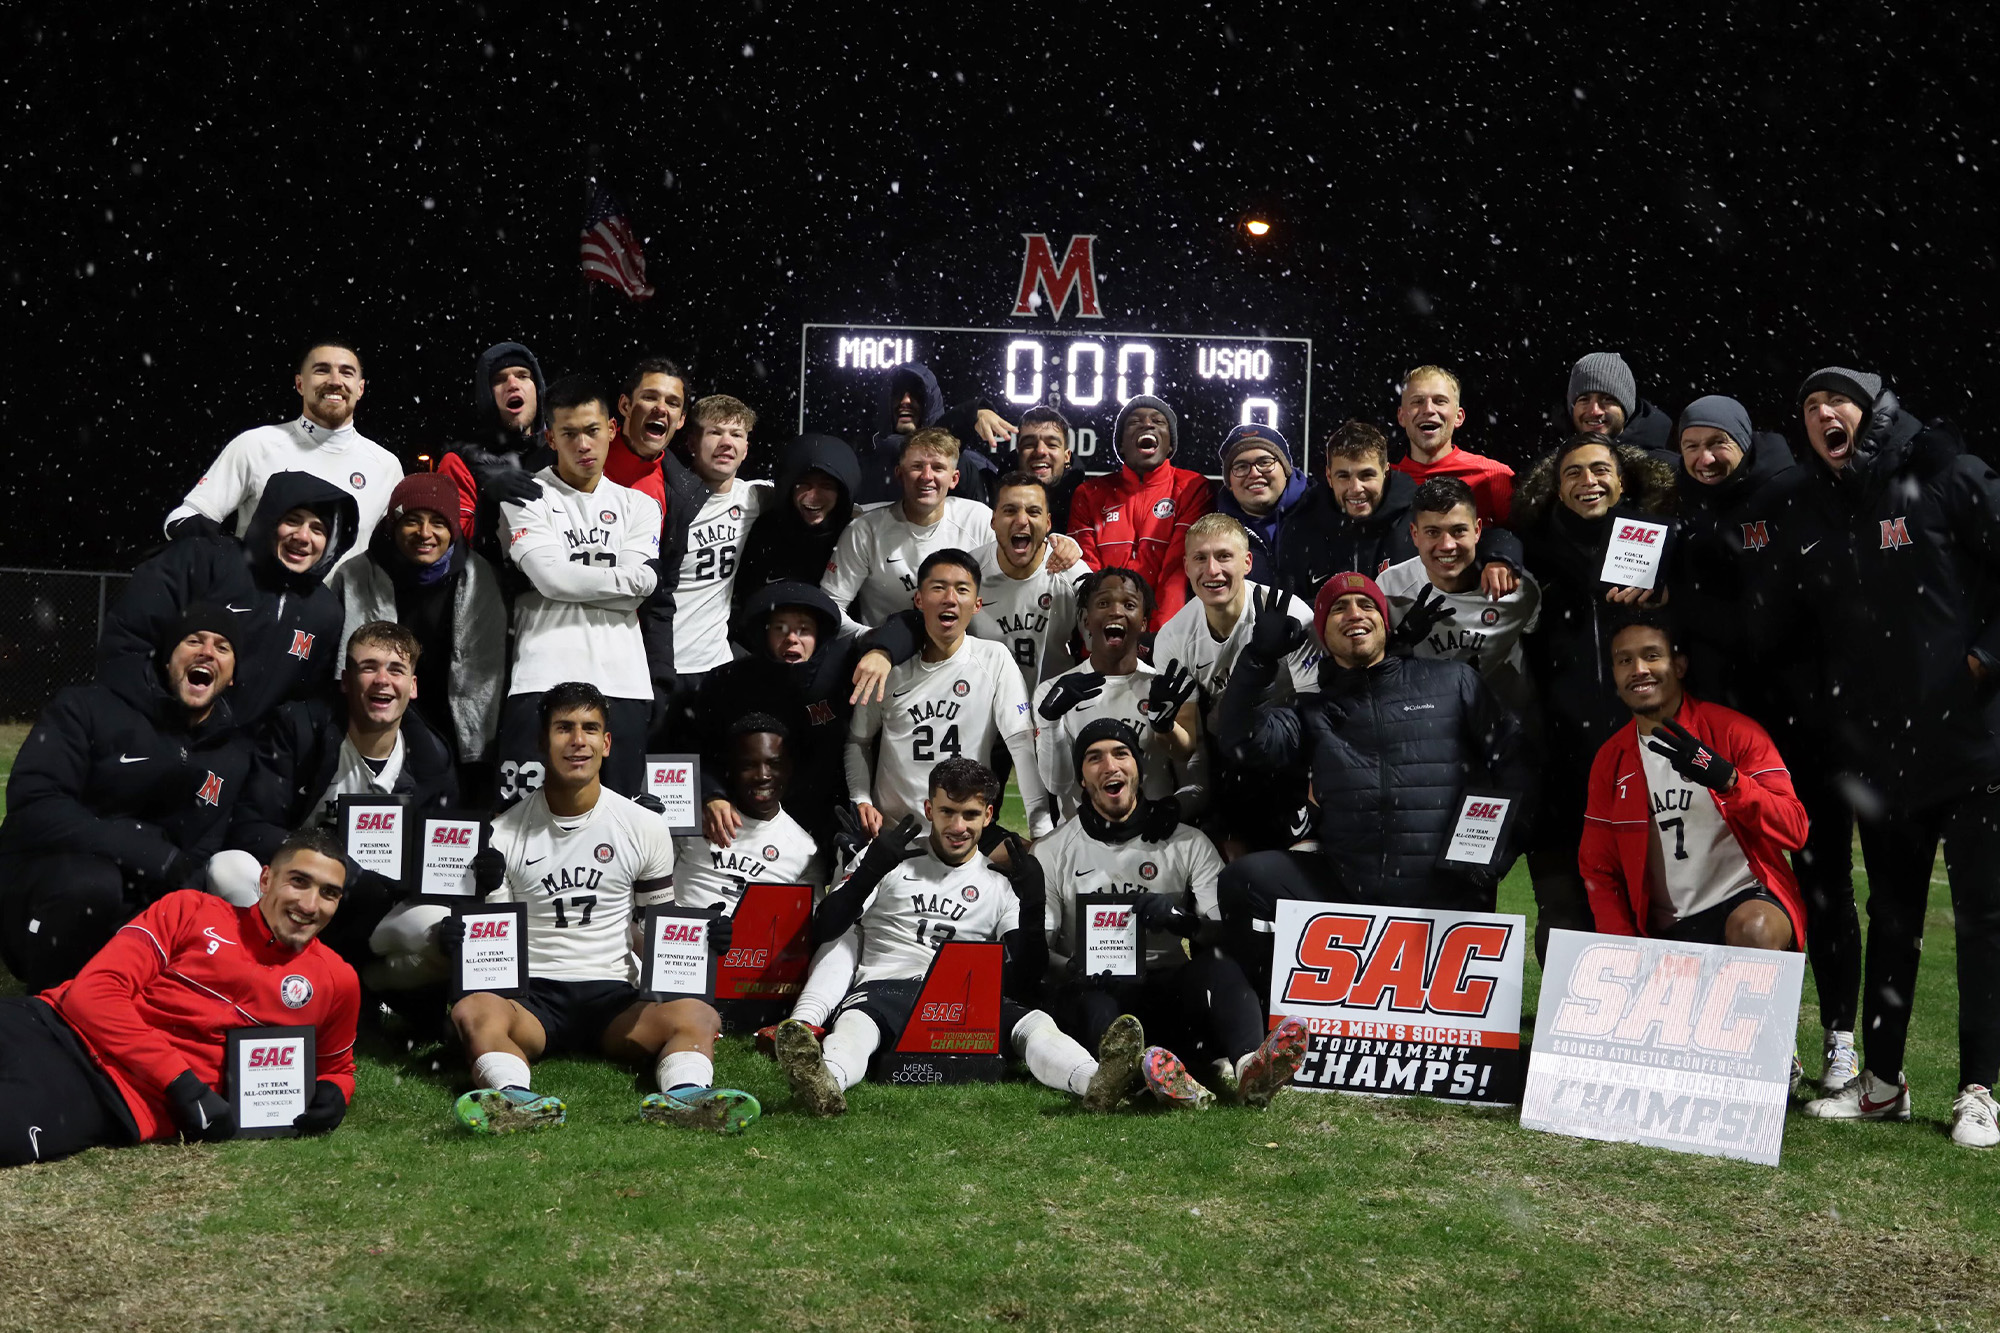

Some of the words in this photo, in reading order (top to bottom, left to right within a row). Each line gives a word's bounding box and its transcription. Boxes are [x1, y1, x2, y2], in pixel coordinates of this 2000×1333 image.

[1010, 232, 1105, 322] M
[1027, 329, 1084, 337] DAKTRONICS
[838, 336, 913, 369] MACU
[1198, 347, 1270, 380] USAO
[1106, 511, 1120, 523] 28
[564, 527, 611, 549] MACU
[692, 524, 737, 548] MACU
[1617, 525, 1660, 545] SAC
[1740, 520, 1770, 552] M
[1879, 516, 1914, 551] M
[696, 545, 737, 581] 26
[996, 612, 1049, 635] MACU
[287, 629, 316, 661] M
[1427, 629, 1487, 655] MACU
[907, 700, 961, 725] MACU
[912, 724, 961, 761] 24
[195, 770, 225, 807] M
[500, 760, 546, 800] 33
[654, 768, 687, 784] SAC
[1620, 785, 1627, 799] 7
[1653, 788, 1693, 814] ACU
[355, 812, 396, 831] SAC
[1465, 802, 1504, 820] SAC
[431, 826, 473, 846] SAC
[1658, 817, 1689, 860] 7
[711, 851, 766, 877] MACU
[541, 866, 603, 896] MACU
[552, 894, 598, 928] 17
[911, 893, 967, 921] MACU
[1092, 911, 1131, 928] SAC
[469, 920, 511, 940] SAC
[662, 923, 703, 943] SAC
[206, 940, 220, 955] 9
[465, 956, 515, 964] ALL-CONFERENCE
[723, 948, 768, 968] SAC
[1280, 911, 1513, 1018] SAC
[920, 1002, 963, 1022] SAC
[1550, 942, 1787, 1059] SAC
[930, 1039, 996, 1050] CHAMPION
[943, 1032, 996, 1040] TOURNAMENT
[1348, 1021, 1406, 1041] MEN'S
[1412, 1027, 1483, 1047] SOCCER
[248, 1045, 296, 1068] SAC
[1315, 1036, 1470, 1062] TOURNAMENT
[1552, 1039, 1604, 1058] SOONER
[1608, 1046, 1669, 1066] ATHLETIC
[1673, 1054, 1763, 1078] CONFERENCE
[892, 1071, 943, 1083] SOCCER
[903, 1063, 933, 1072] MEN'S
[1293, 1051, 1492, 1097] CHAMPS!
